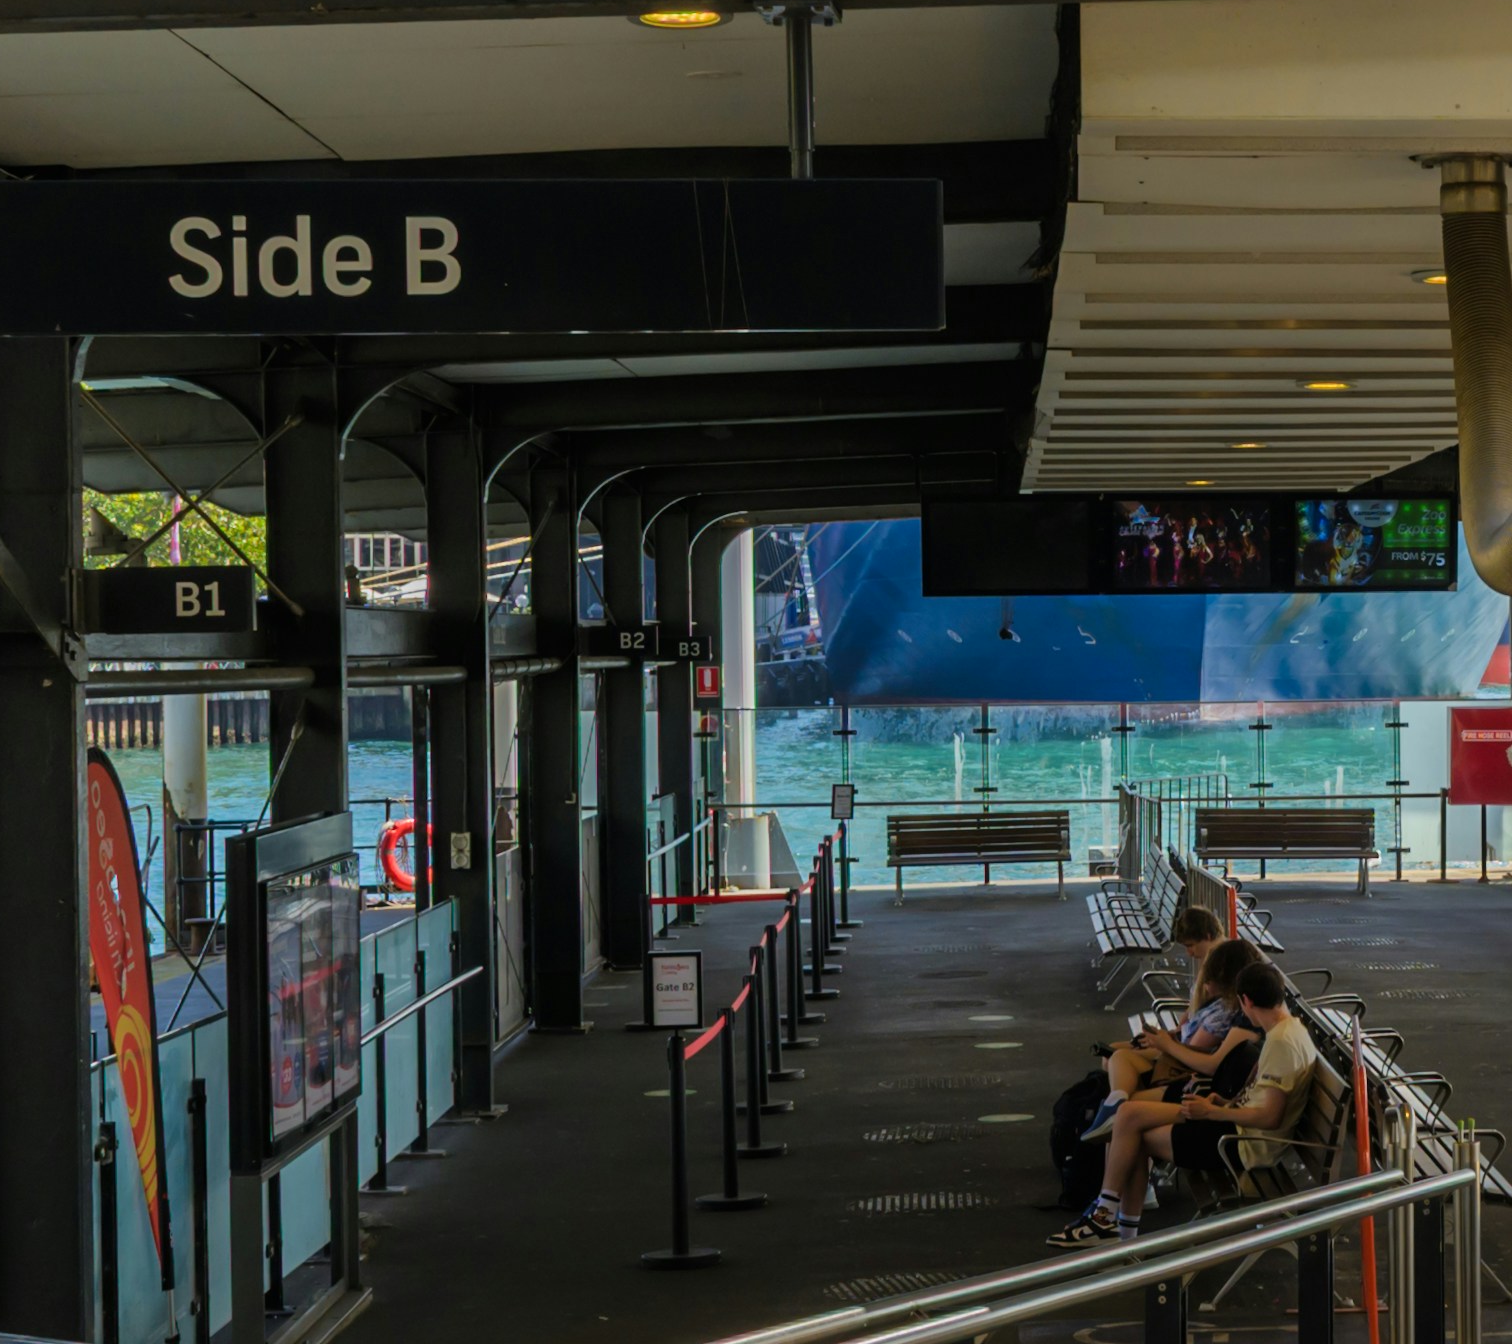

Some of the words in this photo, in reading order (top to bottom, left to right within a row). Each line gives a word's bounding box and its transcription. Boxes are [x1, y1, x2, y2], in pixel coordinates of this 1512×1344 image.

[168, 213, 373, 299] Side
[405, 216, 463, 296] B
[1423, 510, 1446, 521] Zoo
[1398, 524, 1446, 535] Express
[1392, 552, 1419, 561] FROM
[1420, 551, 1446, 567] $75
[175, 580, 226, 617] B1
[619, 632, 645, 649] B2
[678, 642, 700, 657] B3
[655, 983, 680, 992] Gate
[682, 982, 695, 991] B2
